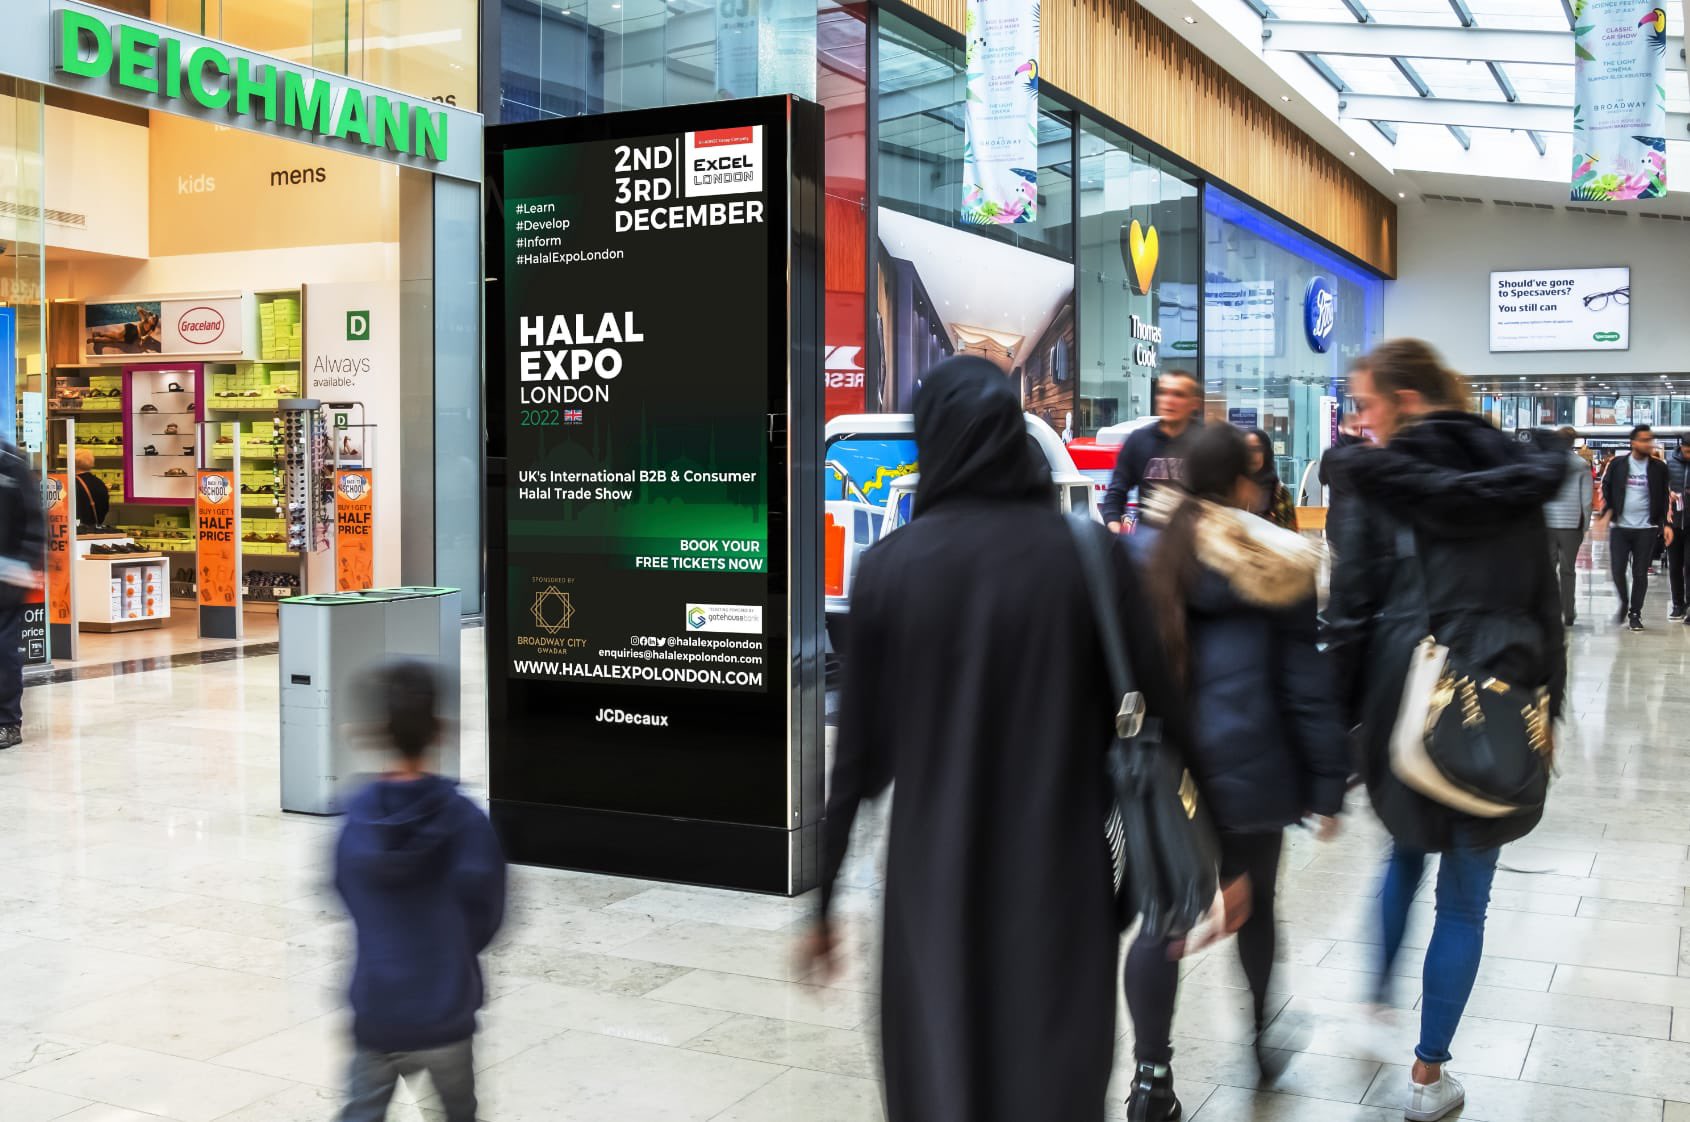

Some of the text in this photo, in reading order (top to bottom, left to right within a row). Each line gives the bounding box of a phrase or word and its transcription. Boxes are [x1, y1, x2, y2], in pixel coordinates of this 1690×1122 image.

[55, 8, 448, 161] DEICHMANN
[1594, 102, 1646, 111] BROADWAY
[614, 145, 673, 172] 2ND
[270, 165, 326, 187] mens
[694, 171, 753, 186] LONDON
[177, 174, 216, 195] kids
[615, 177, 672, 204] 3RD
[516, 202, 555, 214] #Learn
[615, 200, 764, 233] DECEMBER
[516, 218, 570, 232] #Develop
[516, 236, 562, 248] #Inform
[516, 248, 624, 265] #HalalExpoLondon
[1498, 279, 1574, 289] Should've gone
[1498, 287, 1572, 298] to Specsavers?
[1498, 304, 1516, 312] You
[1519, 304, 1538, 312] still
[181, 320, 220, 332] Graceland
[350, 316, 366, 336] D
[520, 311, 644, 346] HALAL
[1131, 314, 1162, 343] Thomas
[1136, 343, 1157, 368] Cook
[313, 355, 370, 377] Always
[520, 347, 622, 382] EXPO
[313, 378, 355, 388] available.
[520, 385, 609, 404] LONDON
[520, 409, 560, 426] 2022
[519, 470, 756, 482] UK's International B2B & Consumer
[204, 487, 227, 496] SCHOOL
[342, 485, 364, 494] SCHOOL
[519, 488, 632, 500] Halal Trade Show
[200, 517, 232, 530] HALF
[338, 512, 371, 524] HALF
[48, 525, 67, 538] LF
[680, 540, 760, 552] BOOK YOUR
[636, 556, 763, 570] FREE TICKETS NOW
[24, 608, 44, 622] Off
[22, 627, 44, 640] price
[518, 636, 588, 648] BROADWAY CITY
[667, 636, 762, 650] @halalexpolondon
[598, 648, 762, 665] enquiries@halalexpolondon.com
[514, 660, 763, 686] WWW.HALALEXPOLONDON.COM
[595, 708, 668, 727] JCDecaux
